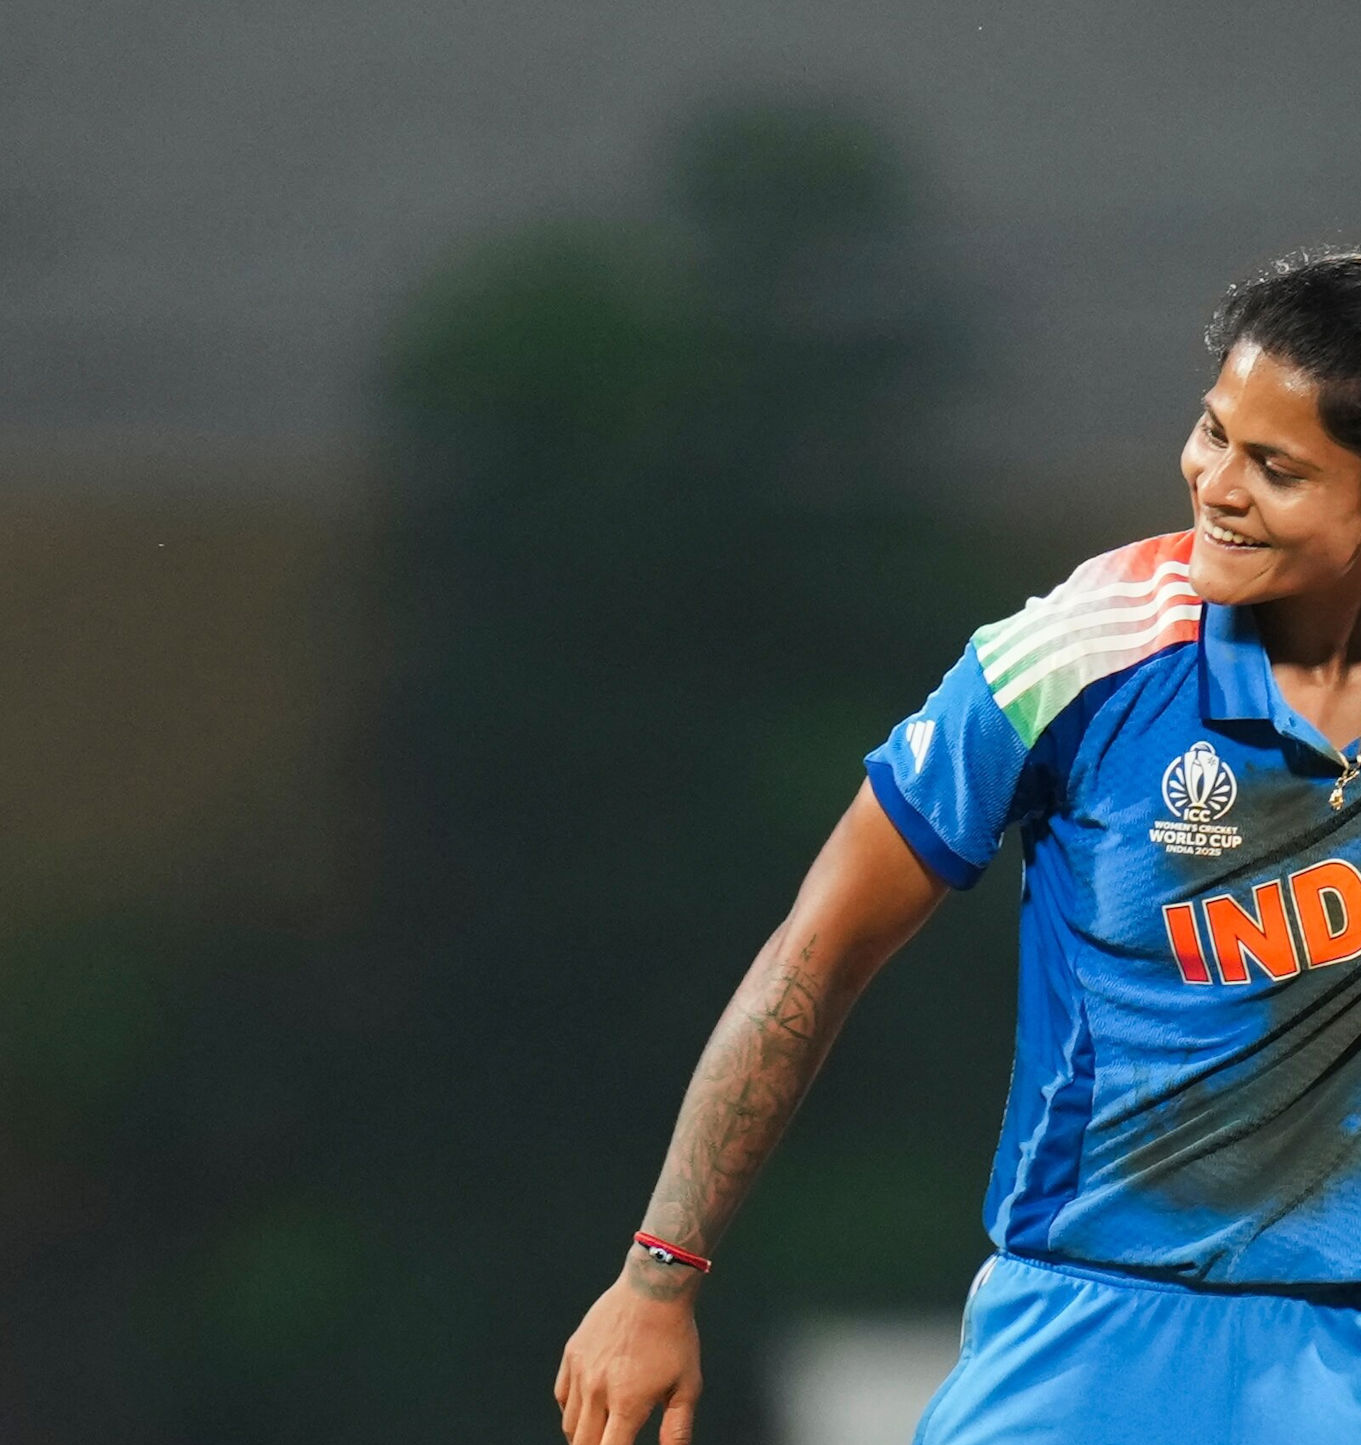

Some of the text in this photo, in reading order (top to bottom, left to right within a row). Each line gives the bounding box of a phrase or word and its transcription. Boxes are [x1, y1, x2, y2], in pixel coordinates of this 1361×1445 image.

[1183, 808, 1211, 822] ICC
[1154, 821, 1238, 834] WOMEN'S CRICKET
[1149, 829, 1242, 848] WORLD CUP
[1166, 844, 1222, 857] INDIA 2025
